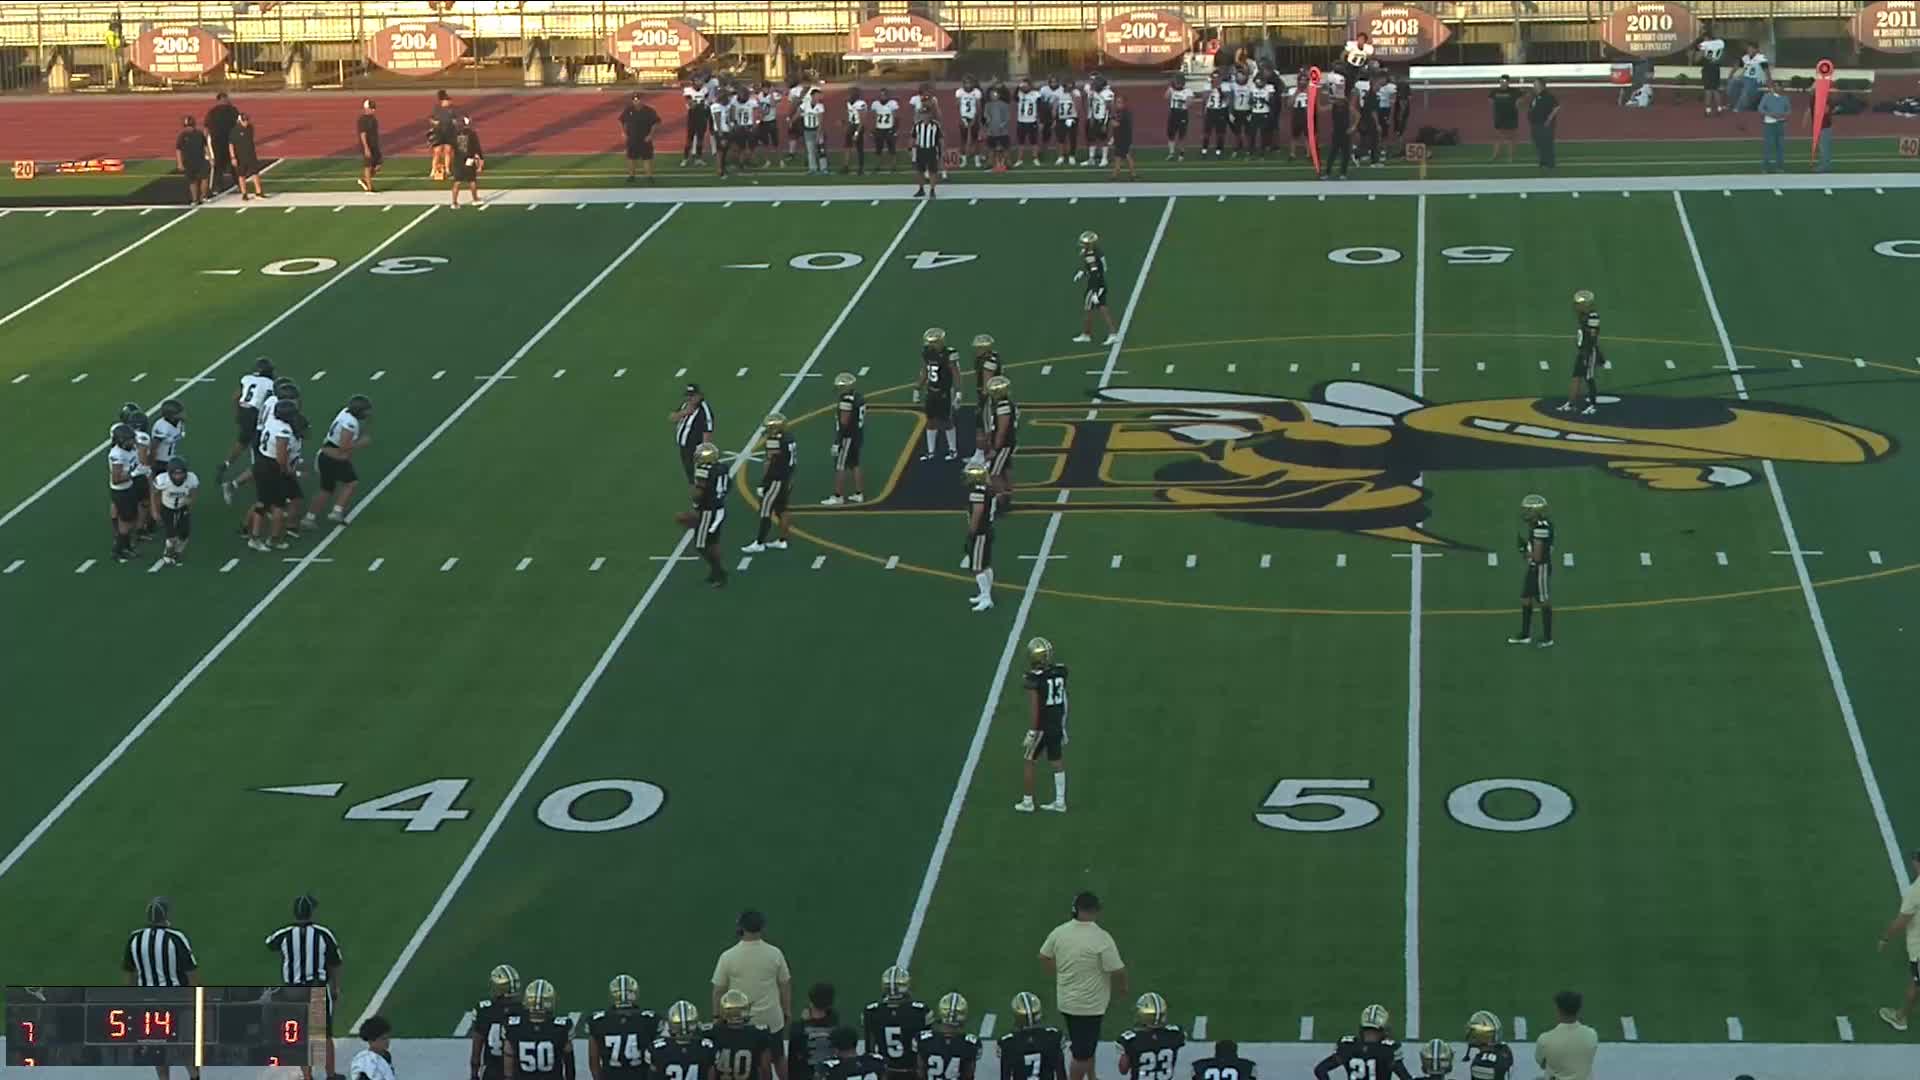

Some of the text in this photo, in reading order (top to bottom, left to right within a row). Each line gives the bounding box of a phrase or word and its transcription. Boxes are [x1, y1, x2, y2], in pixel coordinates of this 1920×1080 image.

[1371, 19, 1418, 35] 2008
[1627, 15, 1672, 31] 2010
[1876, 11, 1917, 27] 2011
[632, 29, 679, 46] 2005
[874, 26, 922, 42] 2006
[1121, 22, 1168, 39] 2007
[153, 37, 199, 53] 2003
[391, 33, 437, 49] 2004
[1407, 145, 1424, 158] 50
[17, 163, 31, 175] 20
[1046, 677, 1064, 705] 13
[604, 1034, 642, 1067] 74
[884, 1026, 904, 1058] 5
[519, 1041, 555, 1072] 50
[715, 1049, 752, 1080] 40
[1138, 1049, 1174, 1080] 23
[927, 1054, 961, 1080] 24
[1024, 1053, 1041, 1080] 7
